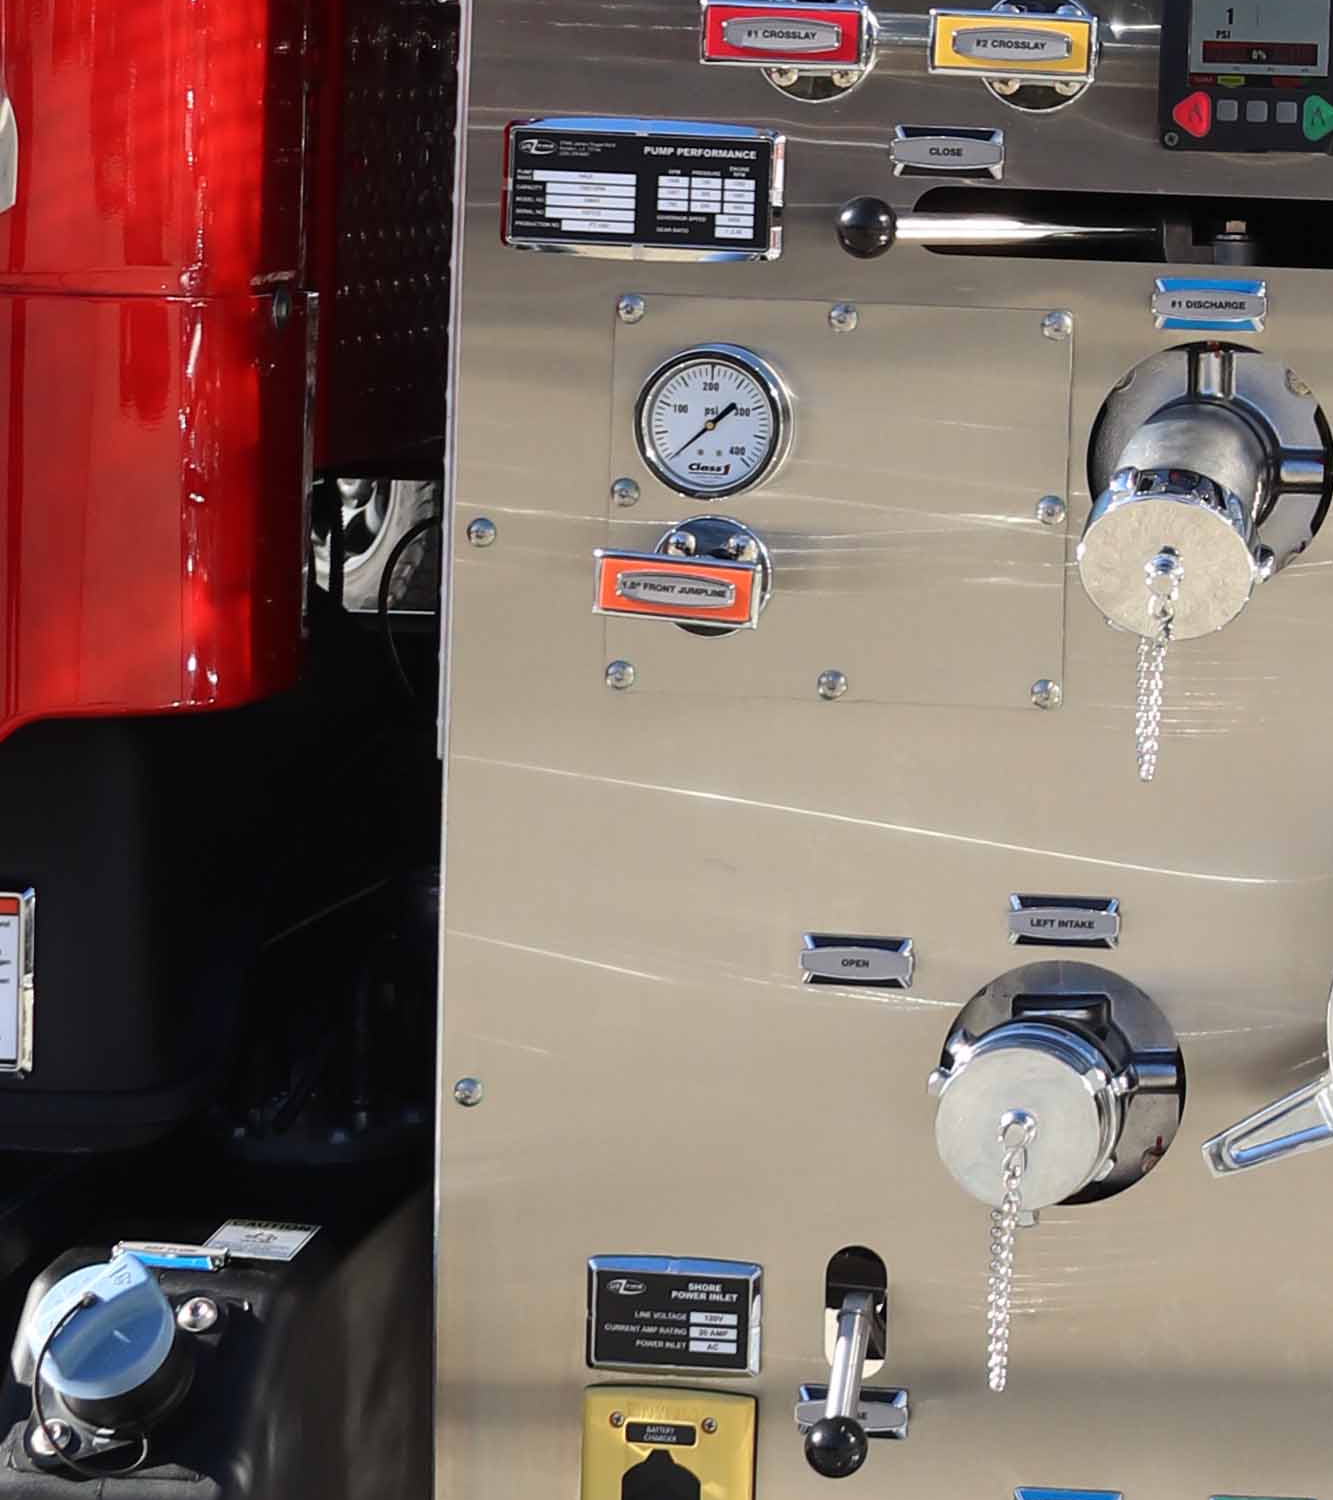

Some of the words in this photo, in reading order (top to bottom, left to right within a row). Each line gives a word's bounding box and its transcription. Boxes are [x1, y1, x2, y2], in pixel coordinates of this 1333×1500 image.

[1226, 8, 1234, 24] 1
[747, 30, 759, 39] #1
[762, 30, 817, 41] CROSSLAY
[1216, 30, 1231, 39] PSI
[976, 39, 988, 49] #2
[990, 40, 1047, 51] CROSSLAY
[643, 146, 674, 156] PUMP
[676, 147, 757, 160] PERFORMANCE
[929, 147, 963, 158] CLOSE
[1171, 300, 1183, 310] #1
[1186, 300, 1246, 311] DISCHARGE
[688, 463, 731, 475] Class1
[643, 582, 674, 592] FRONT
[677, 585, 727, 599] JUMPLINE
[1030, 918, 1055, 928] LEFT
[1057, 919, 1095, 930] INTAKE
[841, 959, 870, 968] OPEN
[688, 1283, 722, 1291] SHORE
[671, 1291, 706, 1301] POWER
[708, 1293, 738, 1302] INLET
[706, 1343, 720, 1351] AC
